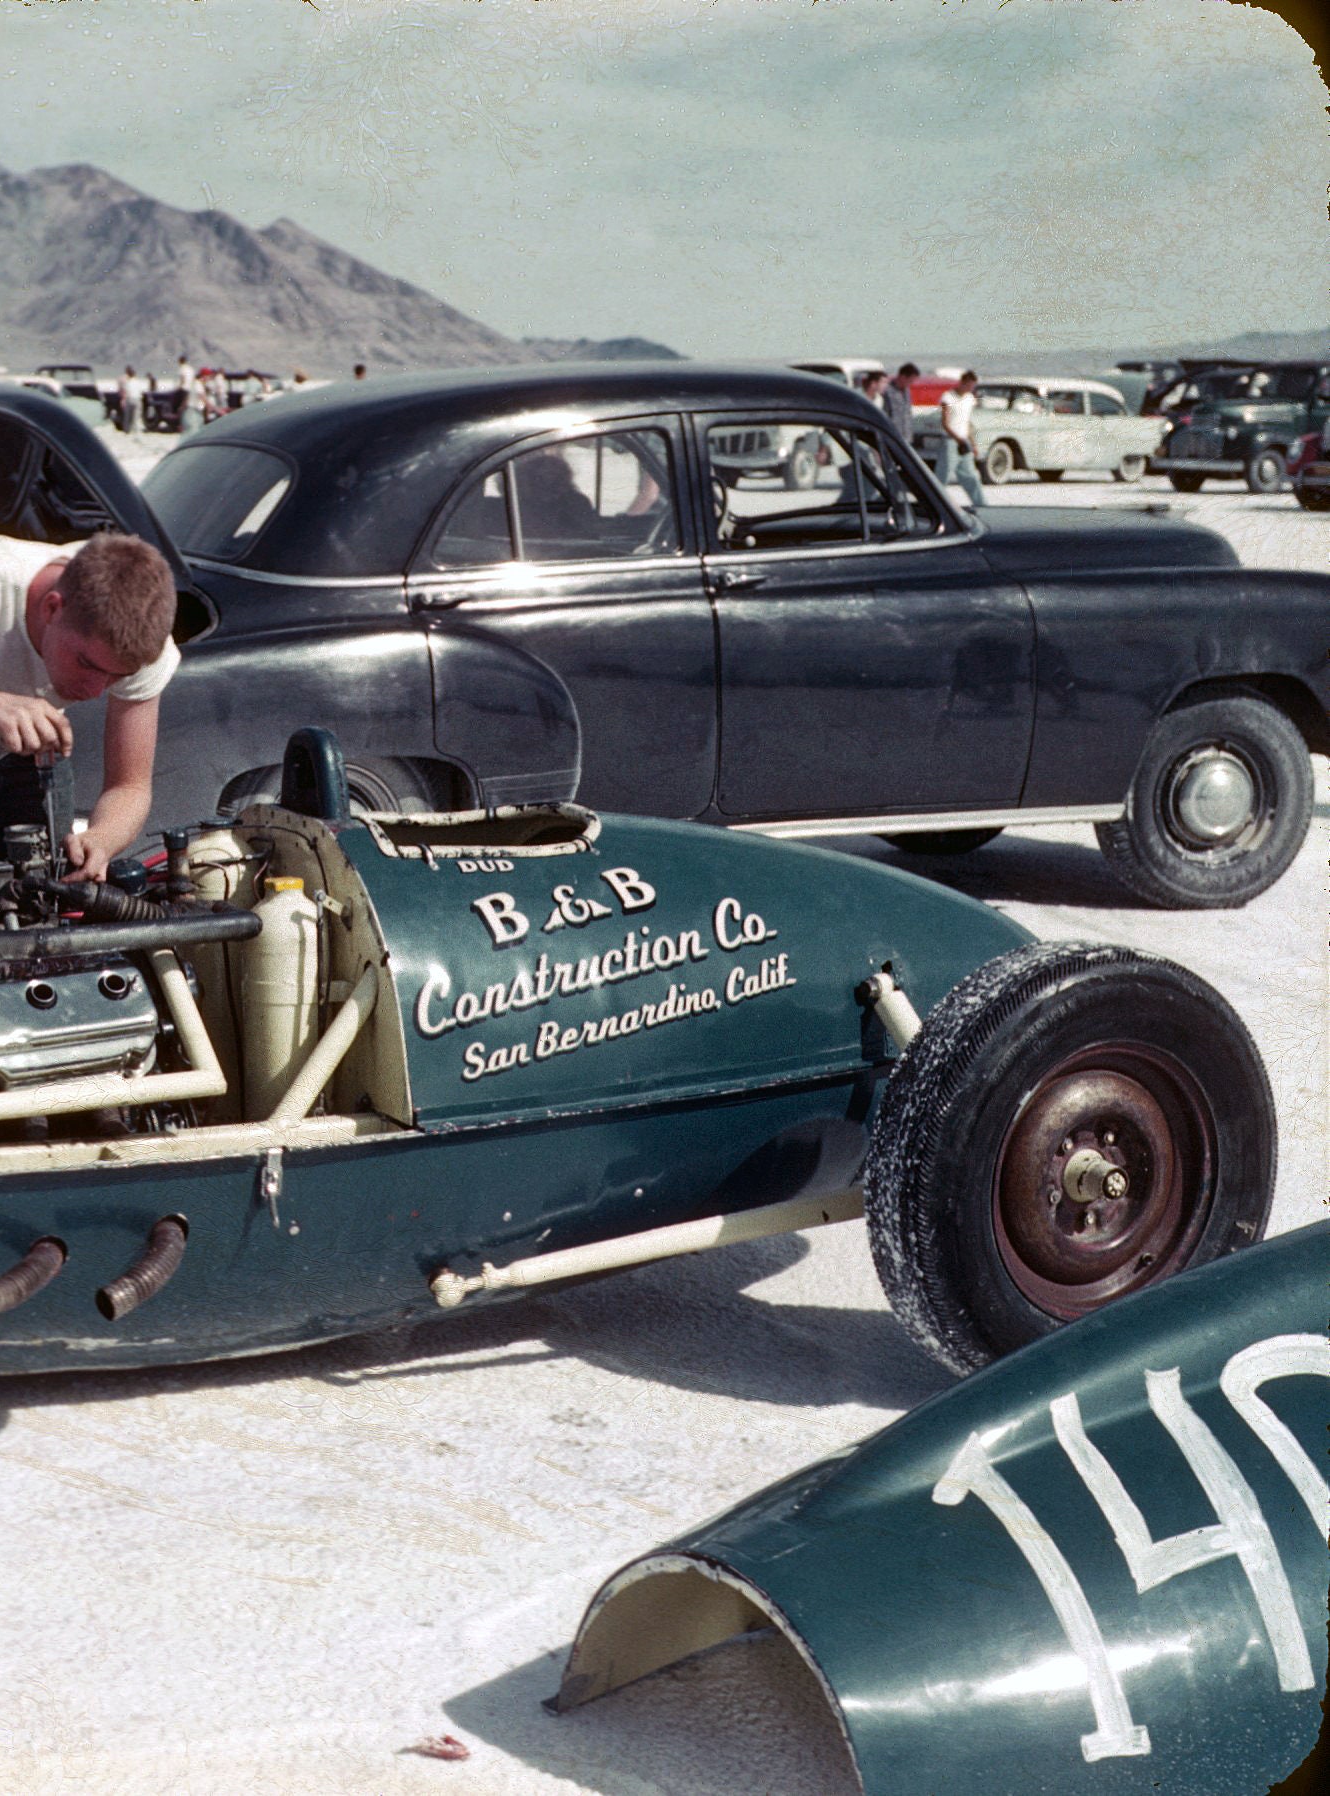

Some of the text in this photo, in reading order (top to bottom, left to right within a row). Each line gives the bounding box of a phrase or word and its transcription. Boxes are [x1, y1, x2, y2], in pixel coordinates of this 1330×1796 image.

[456, 859, 515, 874] DUD
[473, 867, 657, 945] B & B
[415, 926, 710, 1034] Construction
[461, 1042, 530, 1080] San
[535, 984, 722, 1059] Bernardino,
